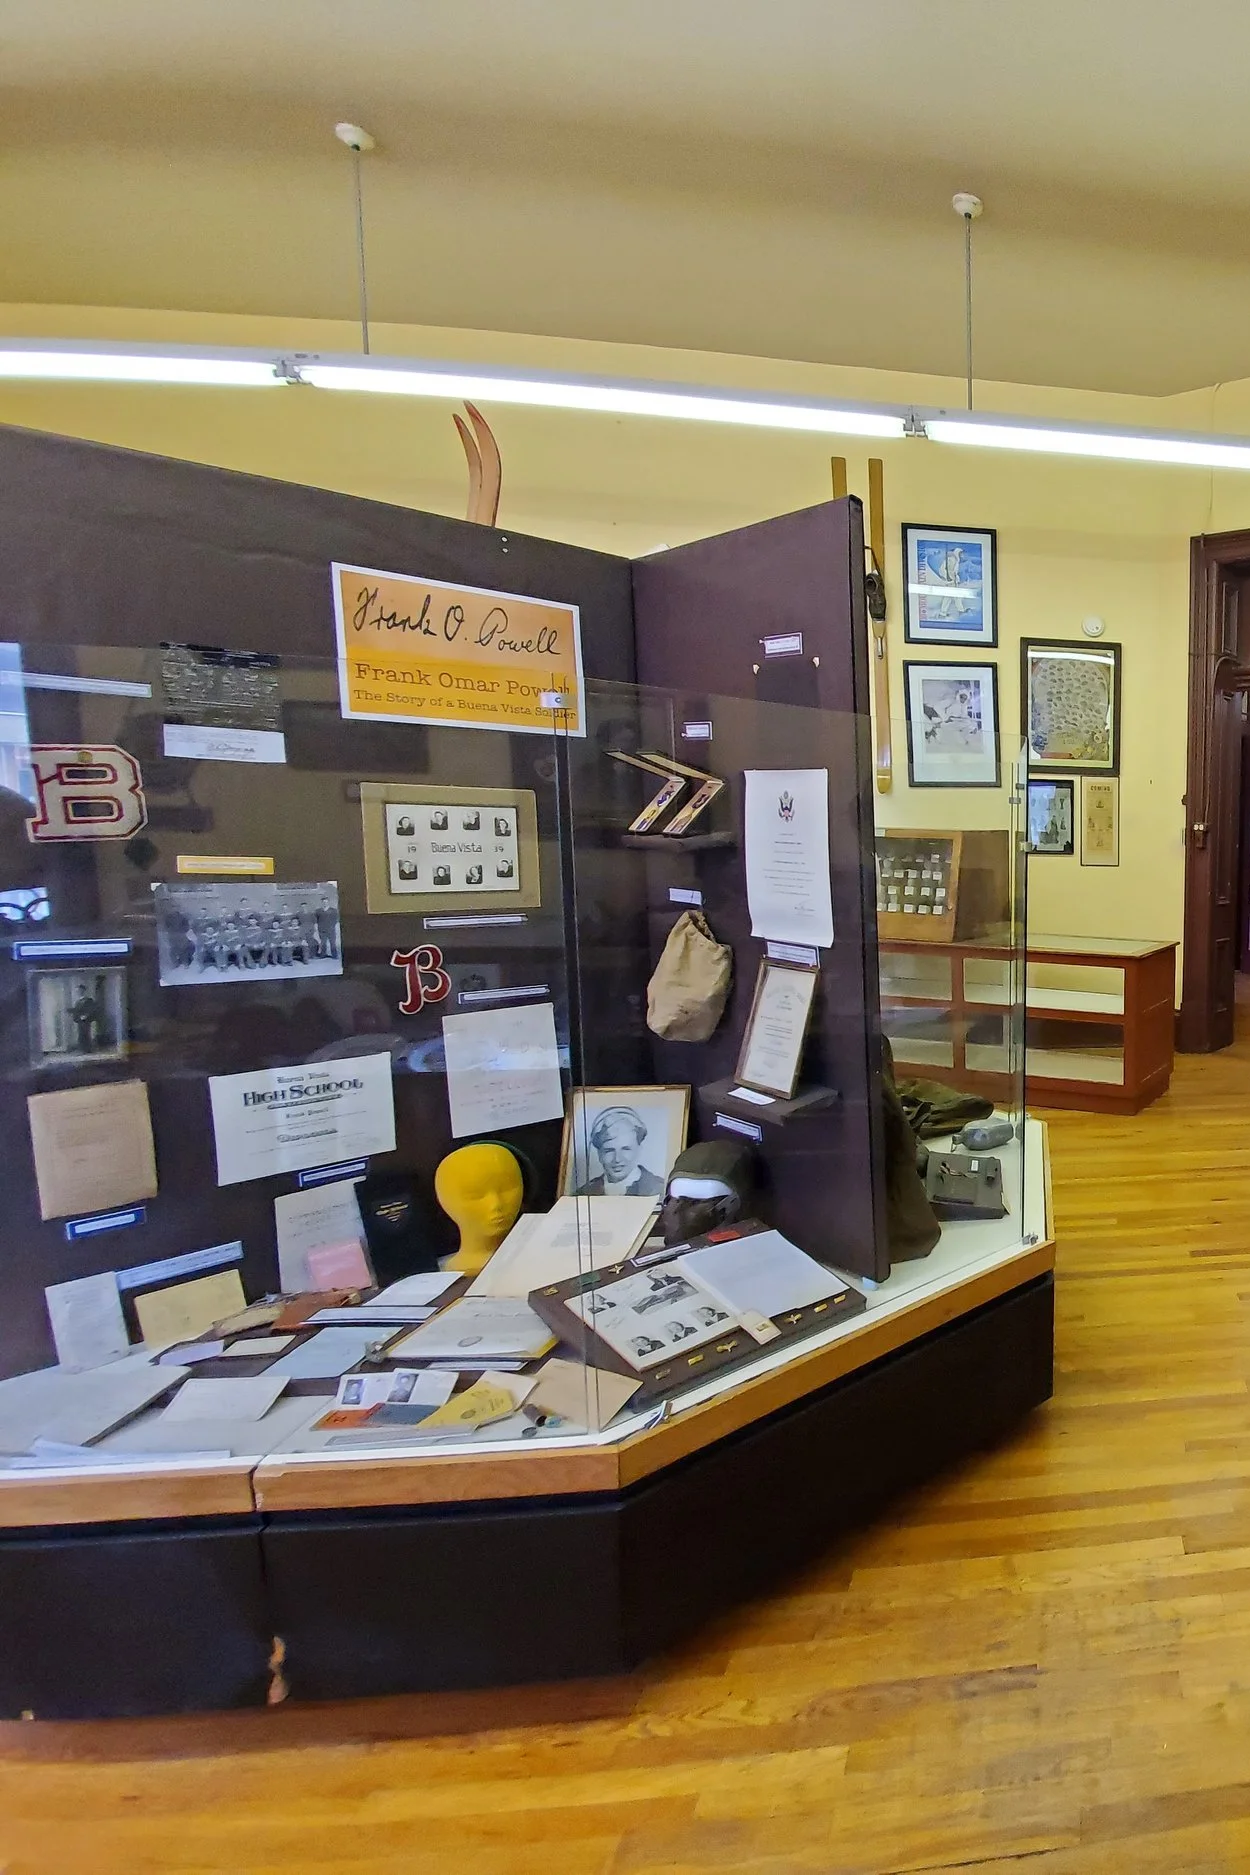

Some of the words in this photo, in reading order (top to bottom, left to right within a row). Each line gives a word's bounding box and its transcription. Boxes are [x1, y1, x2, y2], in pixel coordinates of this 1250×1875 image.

[353, 587, 437, 636] Frank
[475, 607, 561, 655] Powell
[355, 663, 431, 686] Frank
[439, 672, 500, 693] Omar
[354, 690, 381, 702] The
[386, 692, 426, 708] Story
[430, 697, 444, 707] of
[447, 700, 455, 708] a
[459, 698, 498, 713] Buena
[500, 704, 533, 716] Vista
[430, 842, 456, 853] Buena
[457, 842, 483, 853] Vista
[389, 943, 452, 1015] B
[243, 1089, 287, 1107] HIGH
[289, 1078, 364, 1101] SCHOOL
